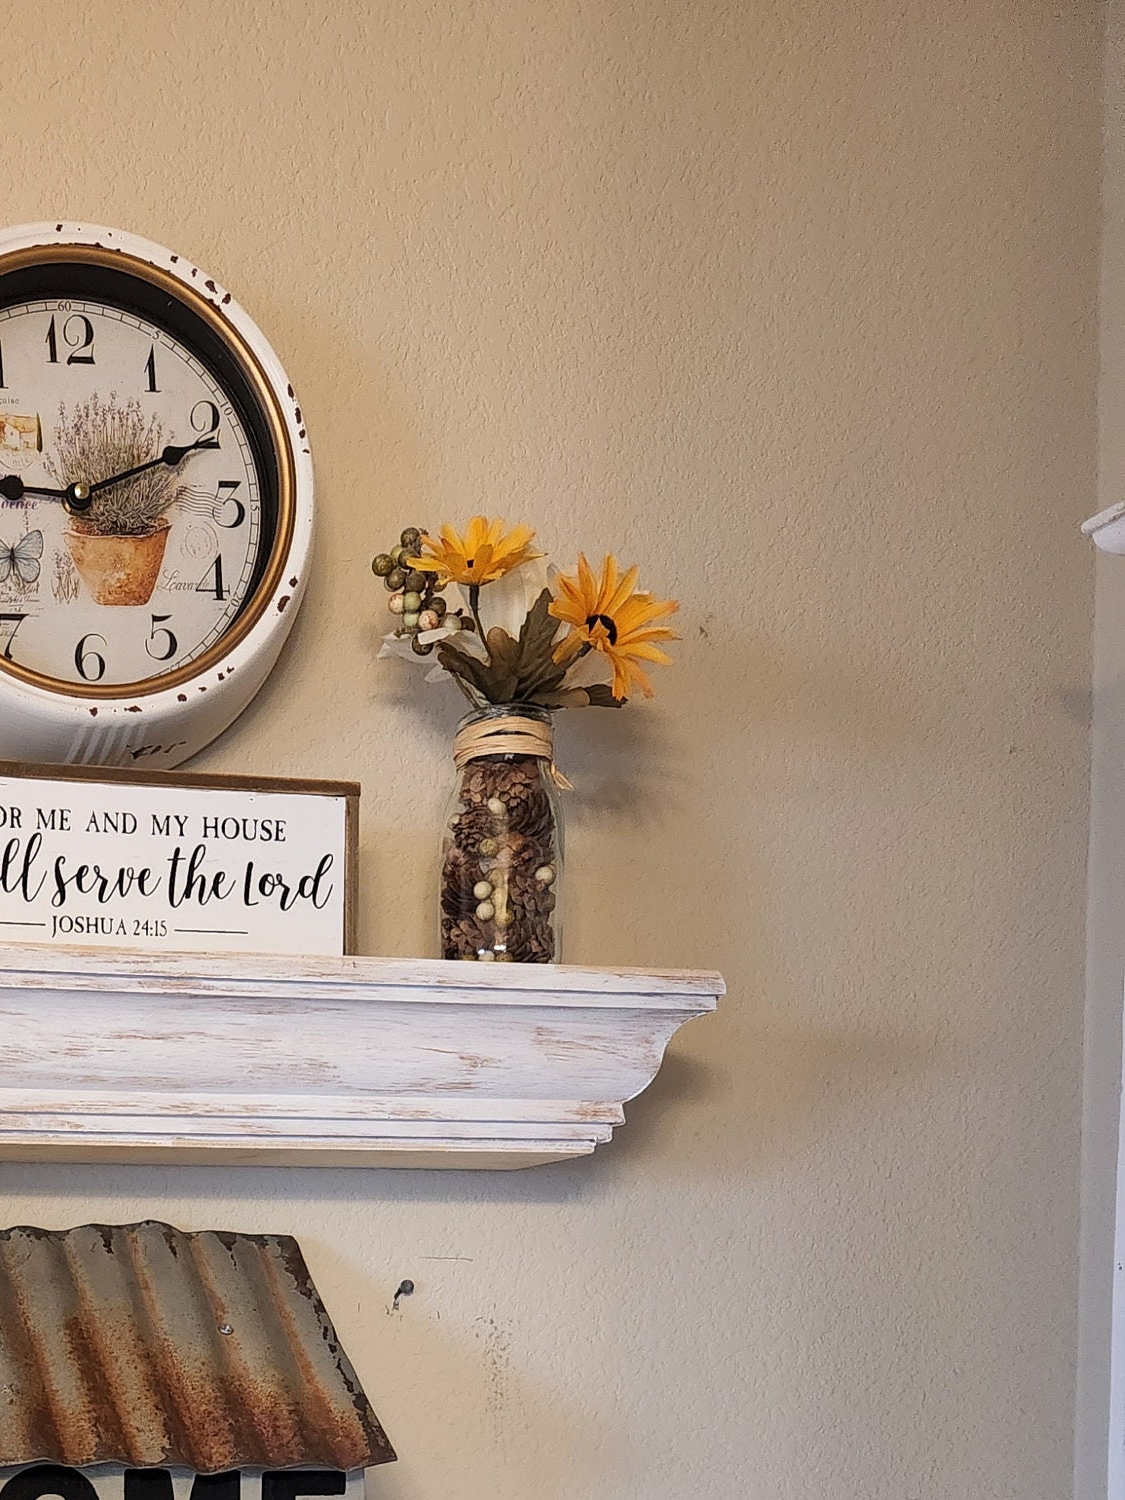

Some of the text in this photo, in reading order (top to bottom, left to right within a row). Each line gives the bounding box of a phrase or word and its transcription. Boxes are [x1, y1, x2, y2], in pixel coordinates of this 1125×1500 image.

[57, 300, 72, 312] 60
[44, 313, 96, 364] 12
[151, 329, 162, 340] 5
[144, 344, 162, 392] 1
[190, 400, 221, 450] 2
[220, 401, 234, 416] 10
[212, 480, 246, 528] 3
[250, 499, 260, 511] 15
[195, 552, 230, 601] 4
[75, 633, 107, 681] 6
[145, 613, 178, 661] 5
[35, 807, 72, 831] ME
[85, 811, 138, 835] AND
[151, 814, 189, 837] MY
[202, 817, 287, 842] HOUSE
[51, 854, 163, 908] serve
[166, 844, 237, 908] the
[244, 853, 335, 911] Lord
[51, 915, 169, 938] JOSHUA 24:15
